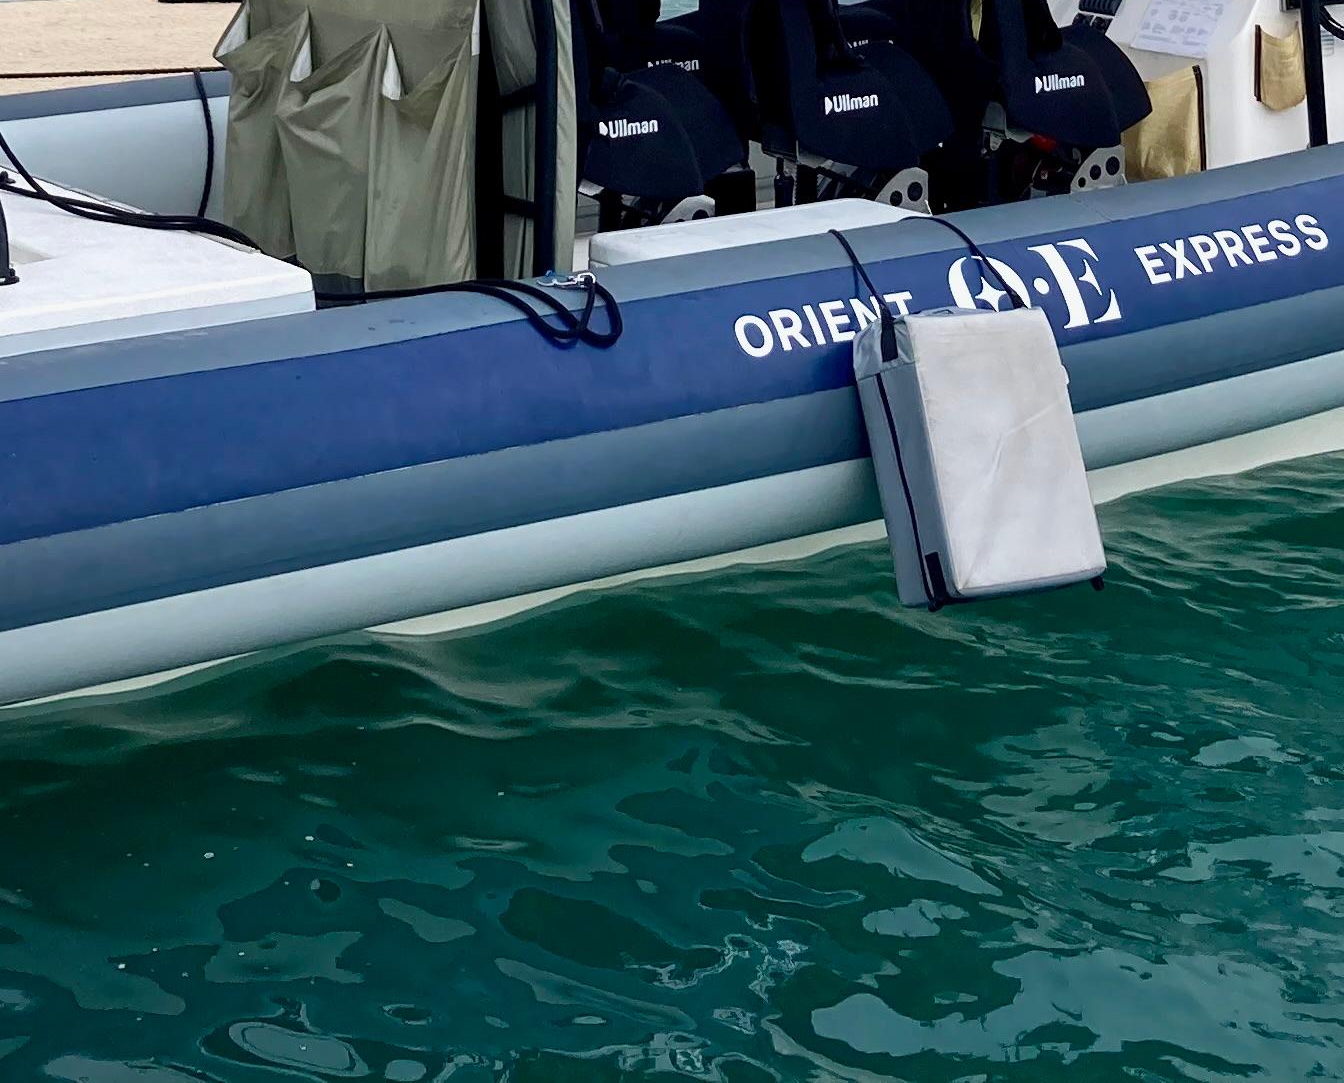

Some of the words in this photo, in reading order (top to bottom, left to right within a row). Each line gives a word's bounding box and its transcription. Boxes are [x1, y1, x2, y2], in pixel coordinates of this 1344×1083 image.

[1041, 74, 1085, 92] Ullman
[832, 94, 879, 113] Ullman
[608, 119, 659, 139] Ullman
[733, 290, 913, 358] ORIENT
[1133, 213, 1330, 285] EXPRESS
